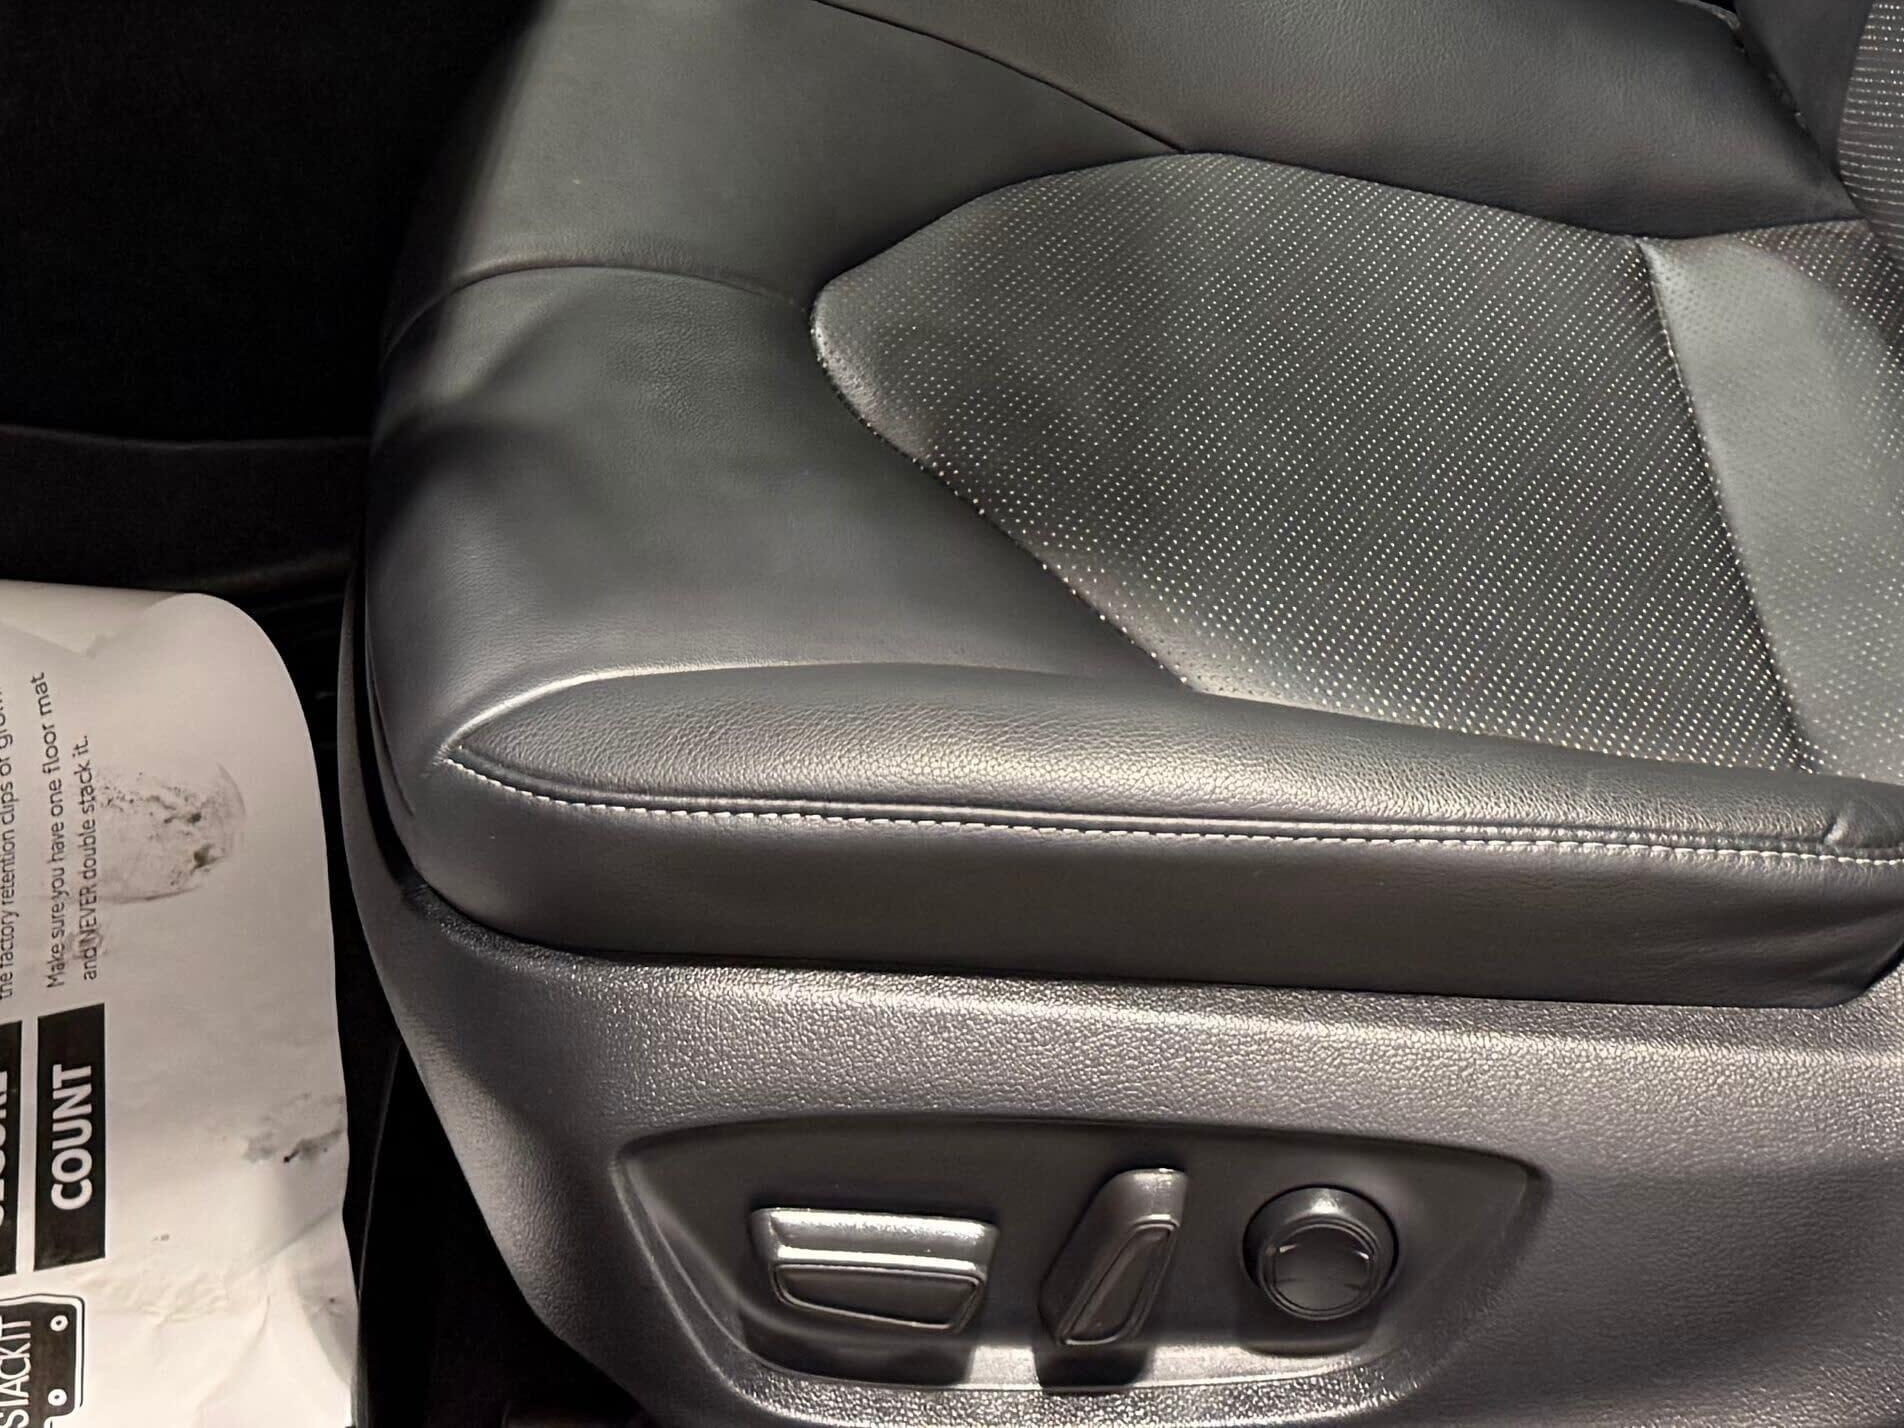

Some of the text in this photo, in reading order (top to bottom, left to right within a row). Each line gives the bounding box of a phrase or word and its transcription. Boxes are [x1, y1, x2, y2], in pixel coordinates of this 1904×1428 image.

[31, 671, 67, 988] Make sure you have one floor mat
[72, 734, 96, 981] and NEVER double stack it.
[50, 1064, 92, 1210] COUNT
